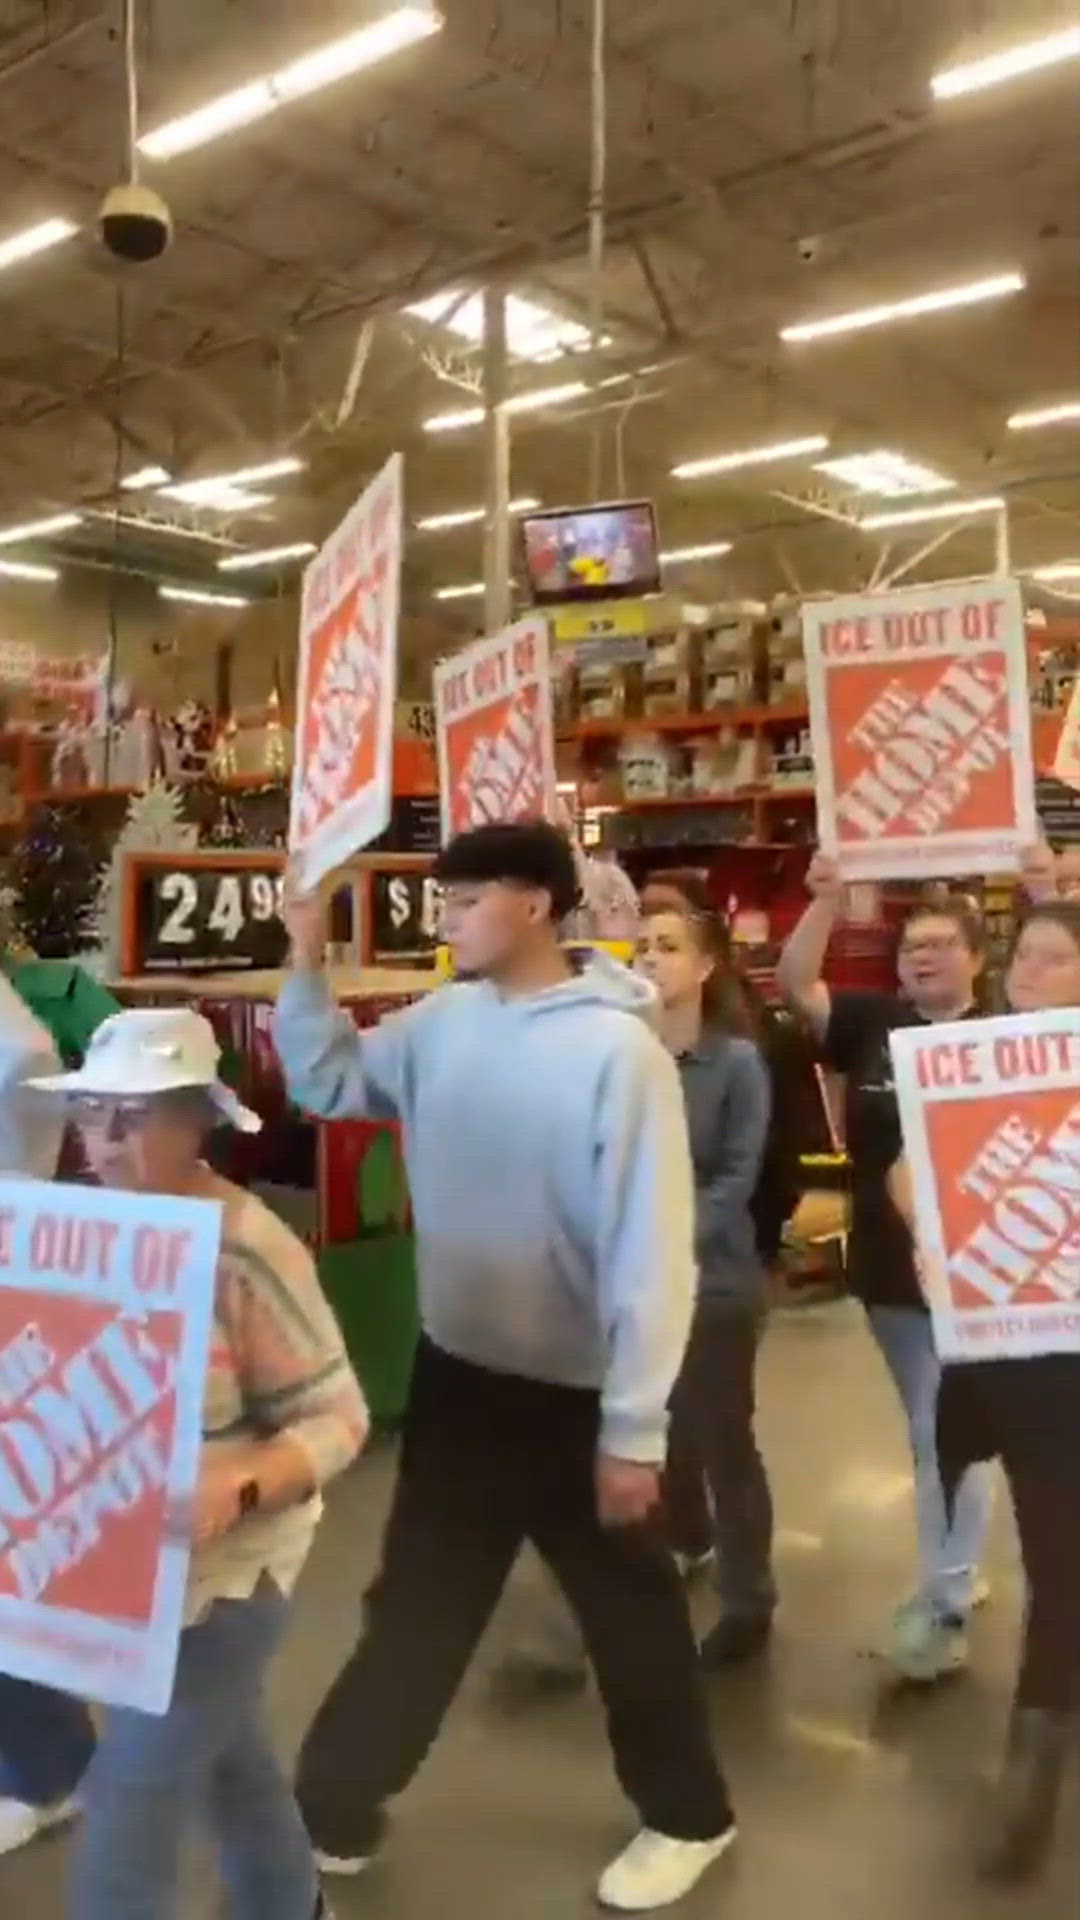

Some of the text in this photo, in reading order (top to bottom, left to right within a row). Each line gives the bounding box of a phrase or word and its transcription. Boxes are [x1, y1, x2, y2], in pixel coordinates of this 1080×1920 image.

[819, 600, 1007, 654] ICE OUT OF
[835, 654, 1007, 839] HOME
[914, 1031, 1074, 1089] ICE OUT
[29, 1212, 119, 1275] OUT
[132, 1225, 193, 1295] OF
[947, 1102, 1080, 1306] HOM
[0, 1303, 168, 1530] OME
